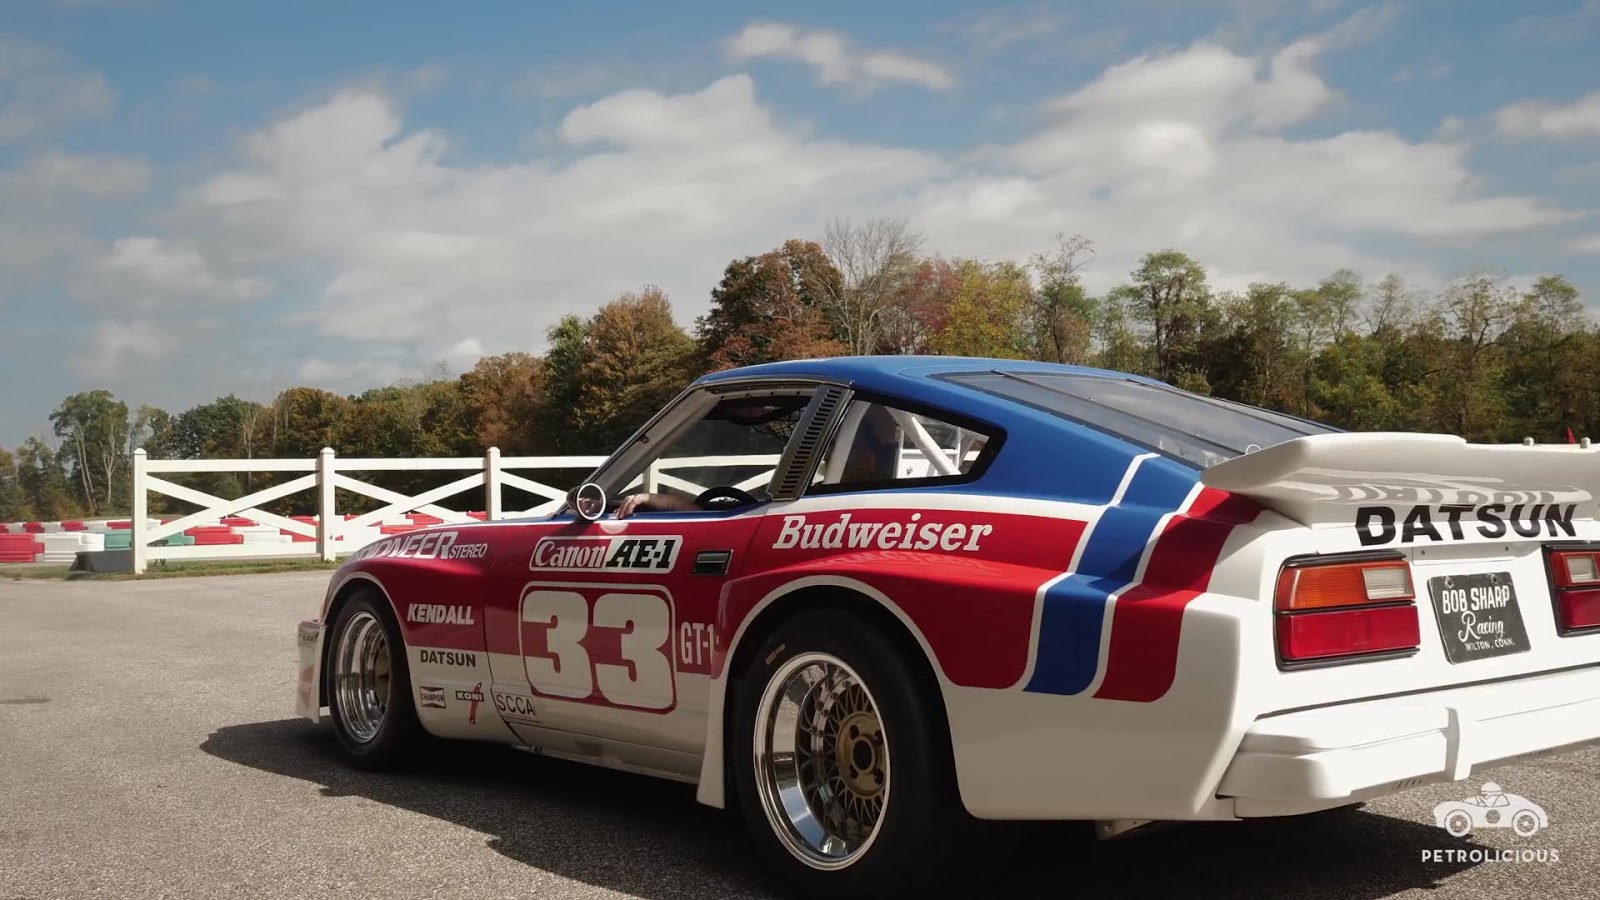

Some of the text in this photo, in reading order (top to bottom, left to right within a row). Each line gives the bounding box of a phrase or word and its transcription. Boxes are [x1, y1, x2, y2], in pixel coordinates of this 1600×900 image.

[772, 513, 993, 551] Budweiser
[1355, 503, 1577, 546] DATSUN
[449, 543, 487, 558] STEREO
[534, 539, 676, 568] Canon AE-1
[407, 603, 474, 625] KENDALL
[1442, 585, 1510, 615] BOB SHARP
[1458, 612, 1504, 642] Racing
[420, 649, 476, 667] DATSUN
[522, 590, 673, 709] 33
[457, 691, 483, 700] KONI
[496, 693, 536, 716] SCCA
